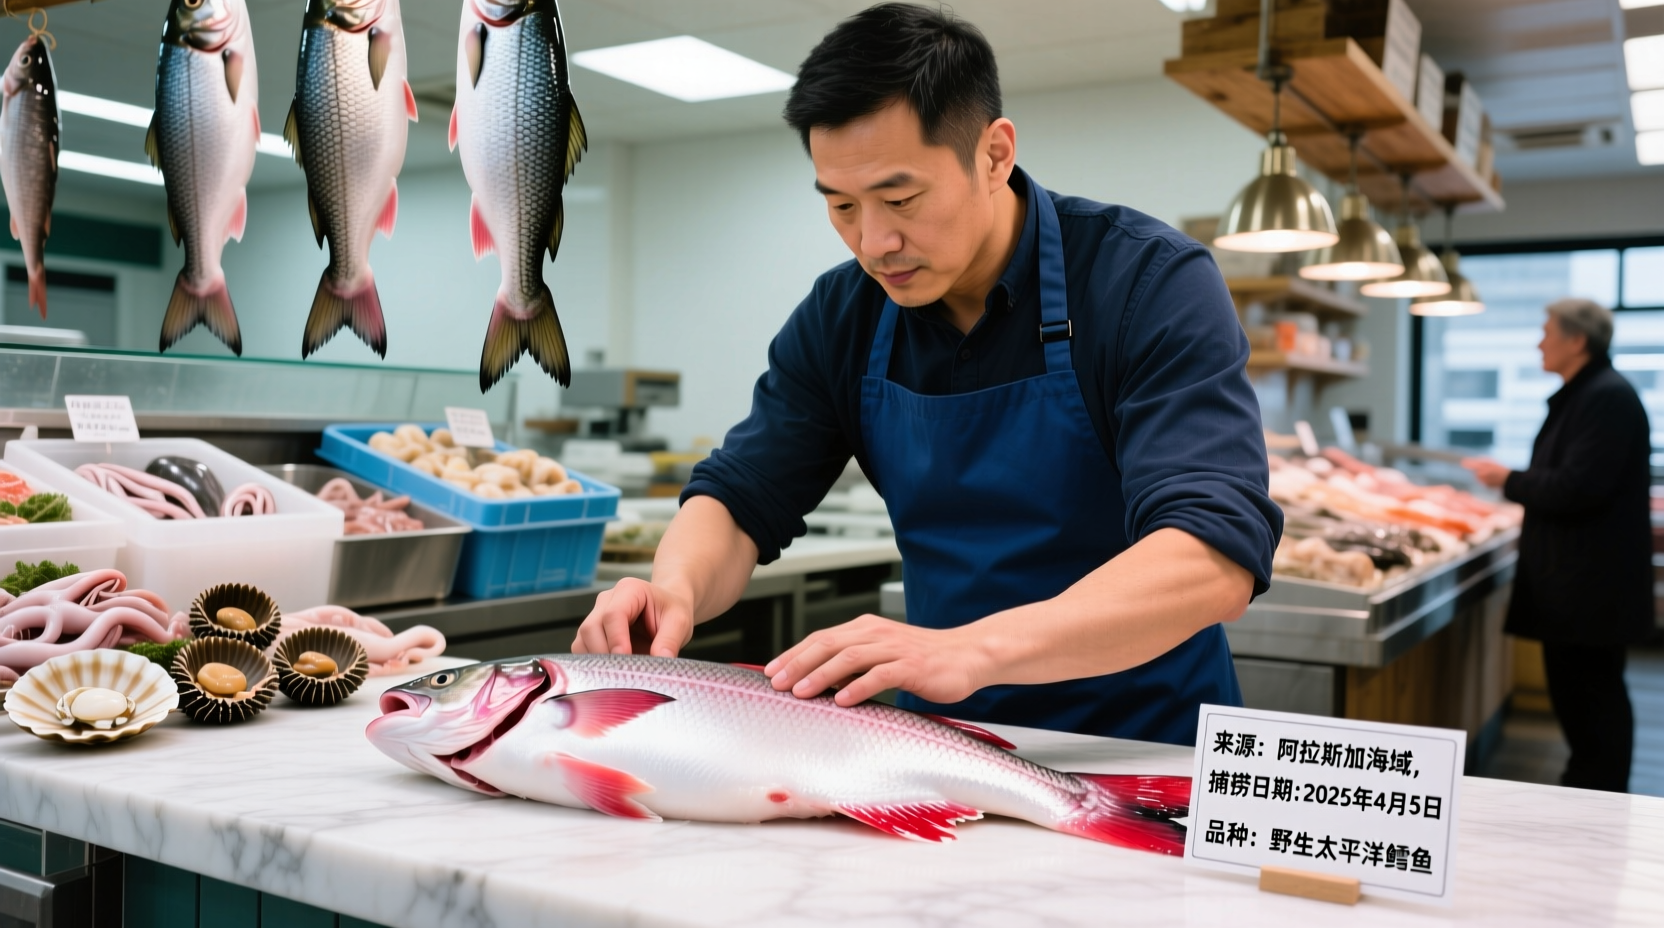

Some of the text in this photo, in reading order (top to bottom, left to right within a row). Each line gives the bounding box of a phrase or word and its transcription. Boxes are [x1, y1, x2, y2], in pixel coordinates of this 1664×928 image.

[1208, 769, 1442, 820] 捕捞日期:2025年4月5日
